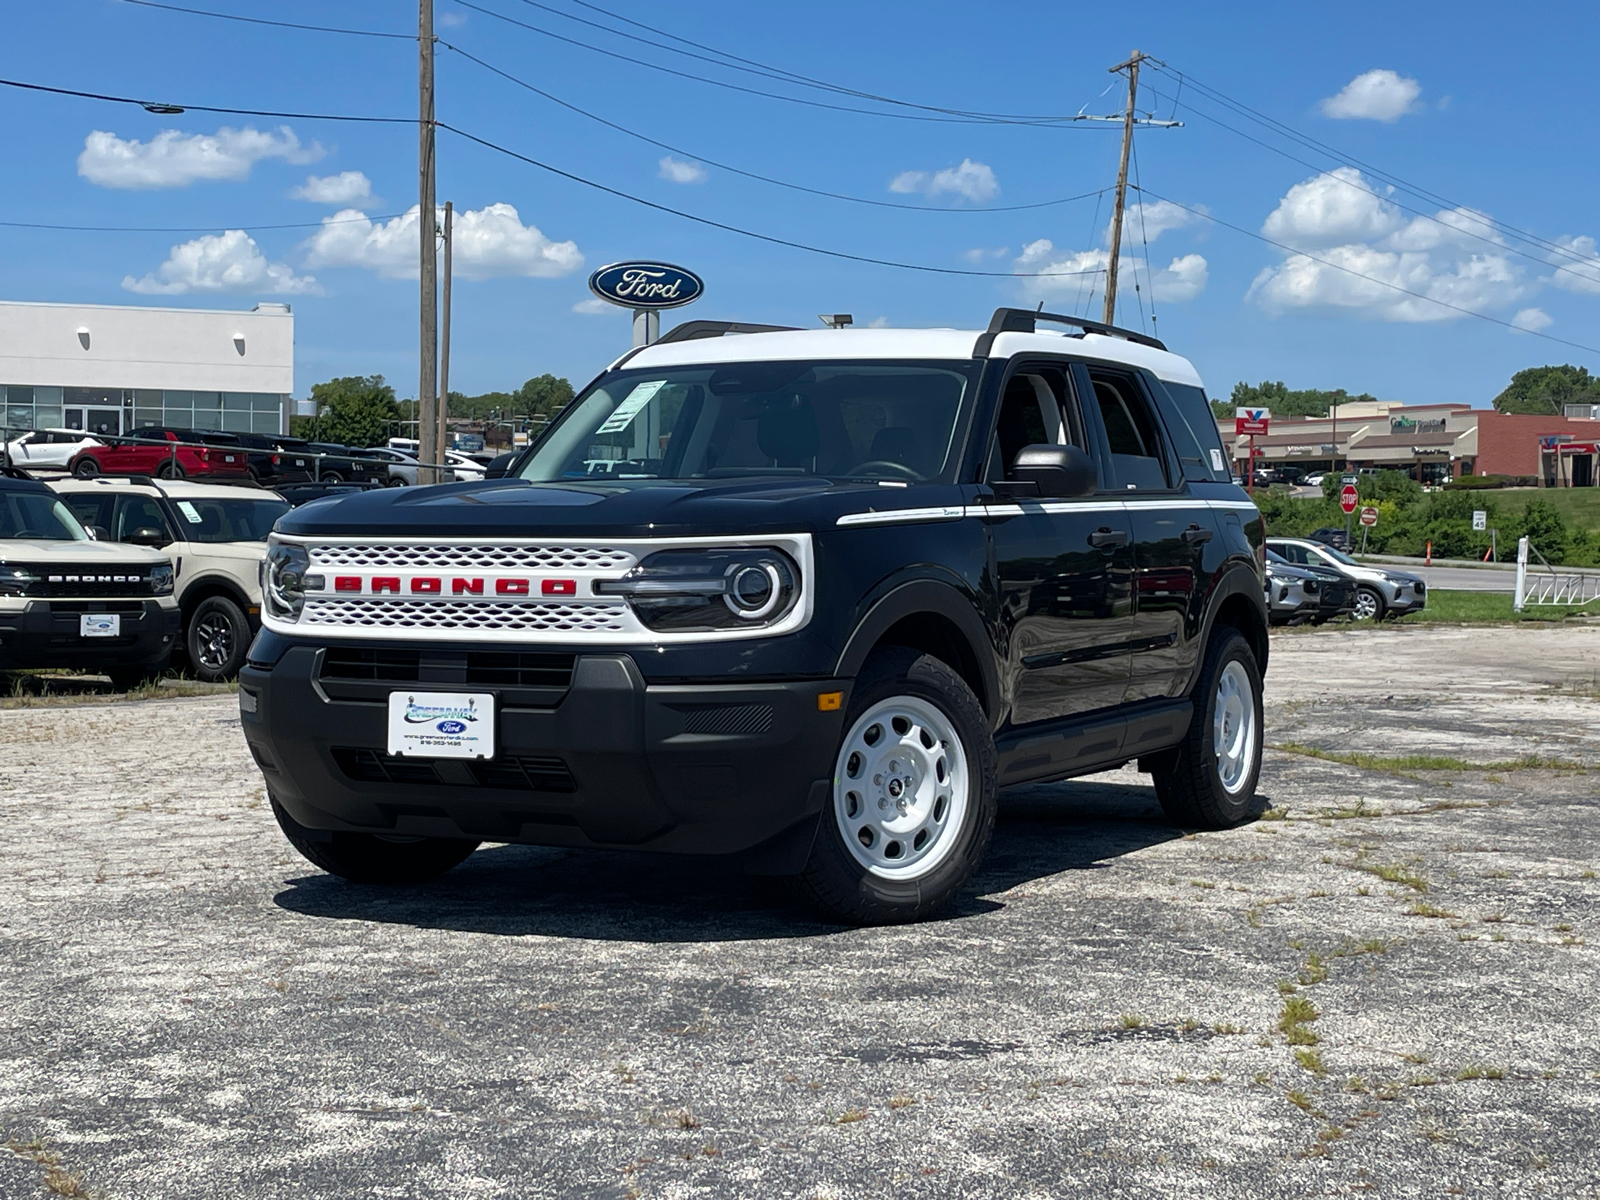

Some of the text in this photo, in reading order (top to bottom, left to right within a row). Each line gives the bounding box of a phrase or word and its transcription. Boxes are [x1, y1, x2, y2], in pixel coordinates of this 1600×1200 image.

[616, 269, 681, 298] Ford
[1342, 493, 1357, 504] STOP
[335, 576, 577, 596] BRONCO
[406, 703, 477, 719] GREENWAY
[442, 721, 461, 732] Ford
